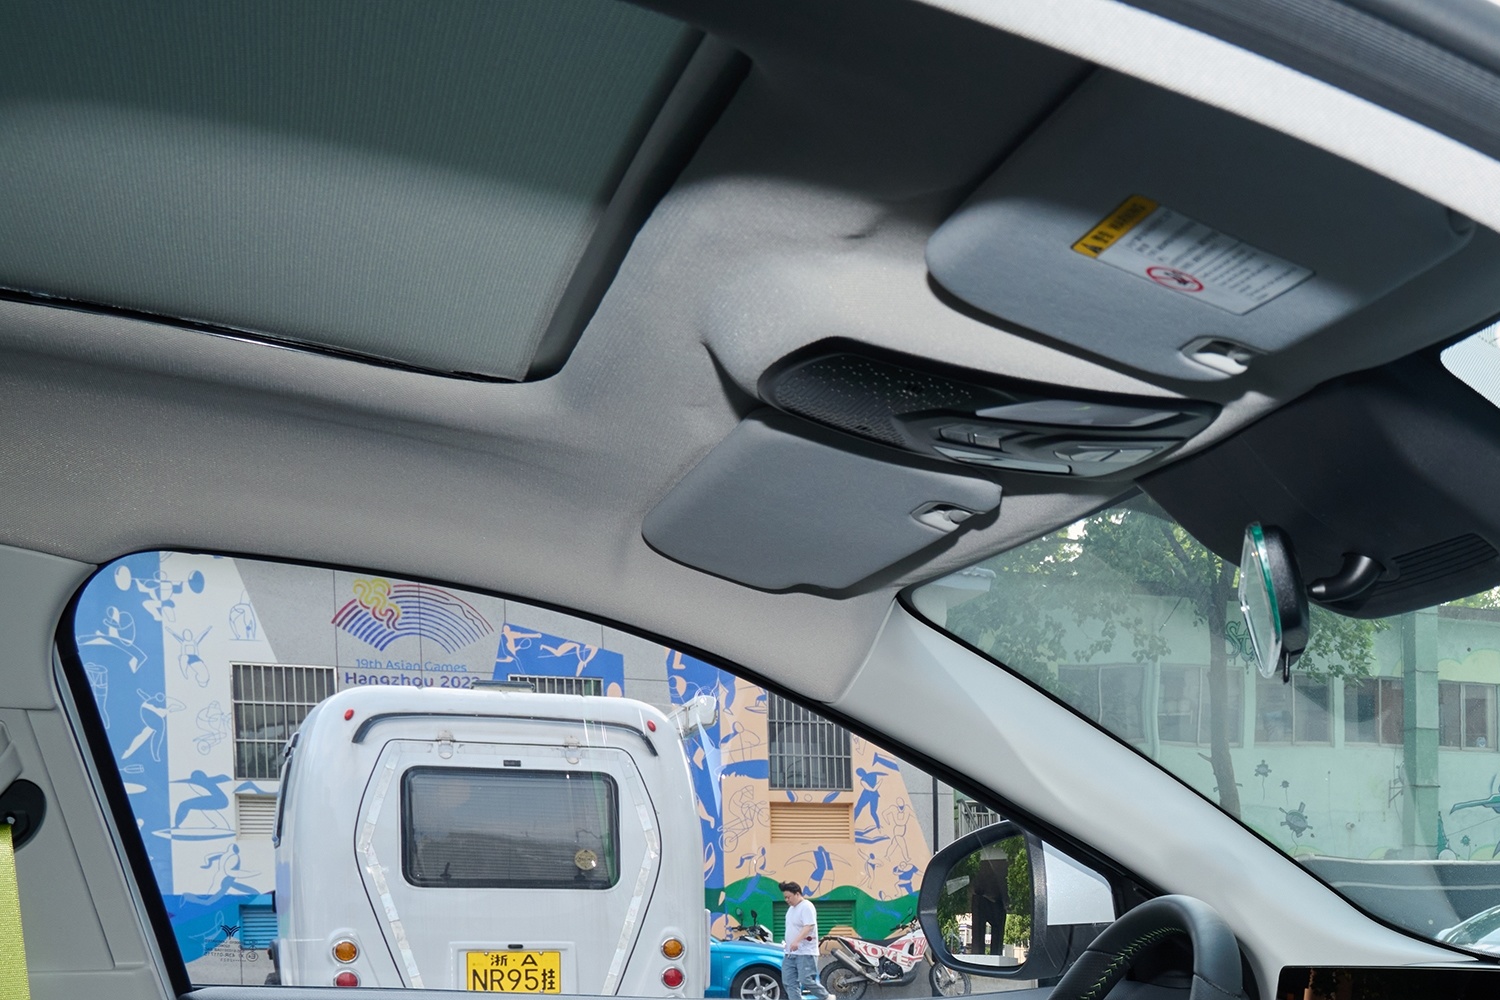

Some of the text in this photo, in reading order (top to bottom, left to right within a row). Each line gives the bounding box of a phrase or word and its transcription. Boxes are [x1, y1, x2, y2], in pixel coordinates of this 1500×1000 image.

[355, 658, 467, 672] 19th Asian Games
[345, 672, 434, 687] Hangzhou
[472, 968, 555, 991] NR95挂
